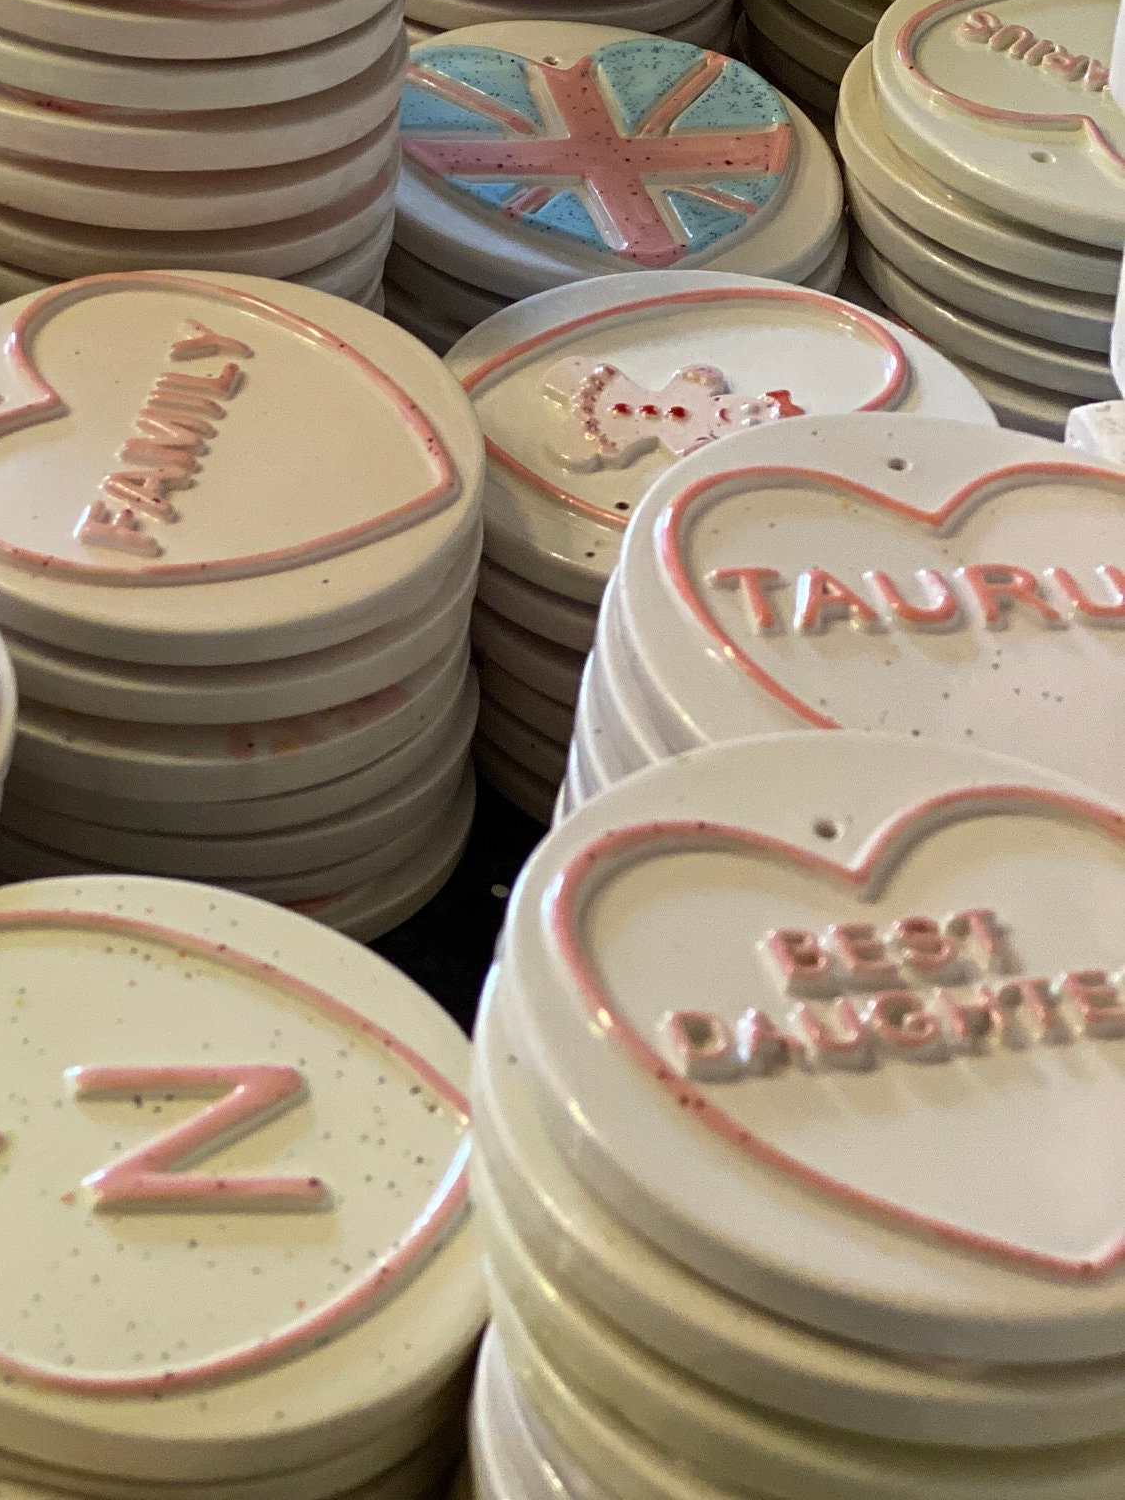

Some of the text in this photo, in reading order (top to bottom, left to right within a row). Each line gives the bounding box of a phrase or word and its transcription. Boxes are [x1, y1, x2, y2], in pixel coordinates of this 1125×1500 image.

[72, 317, 257, 560] FAMILY
[757, 906, 1020, 998] BEST
[658, 964, 1125, 1083] DAUGHTE
[62, 1062, 335, 1215] N
